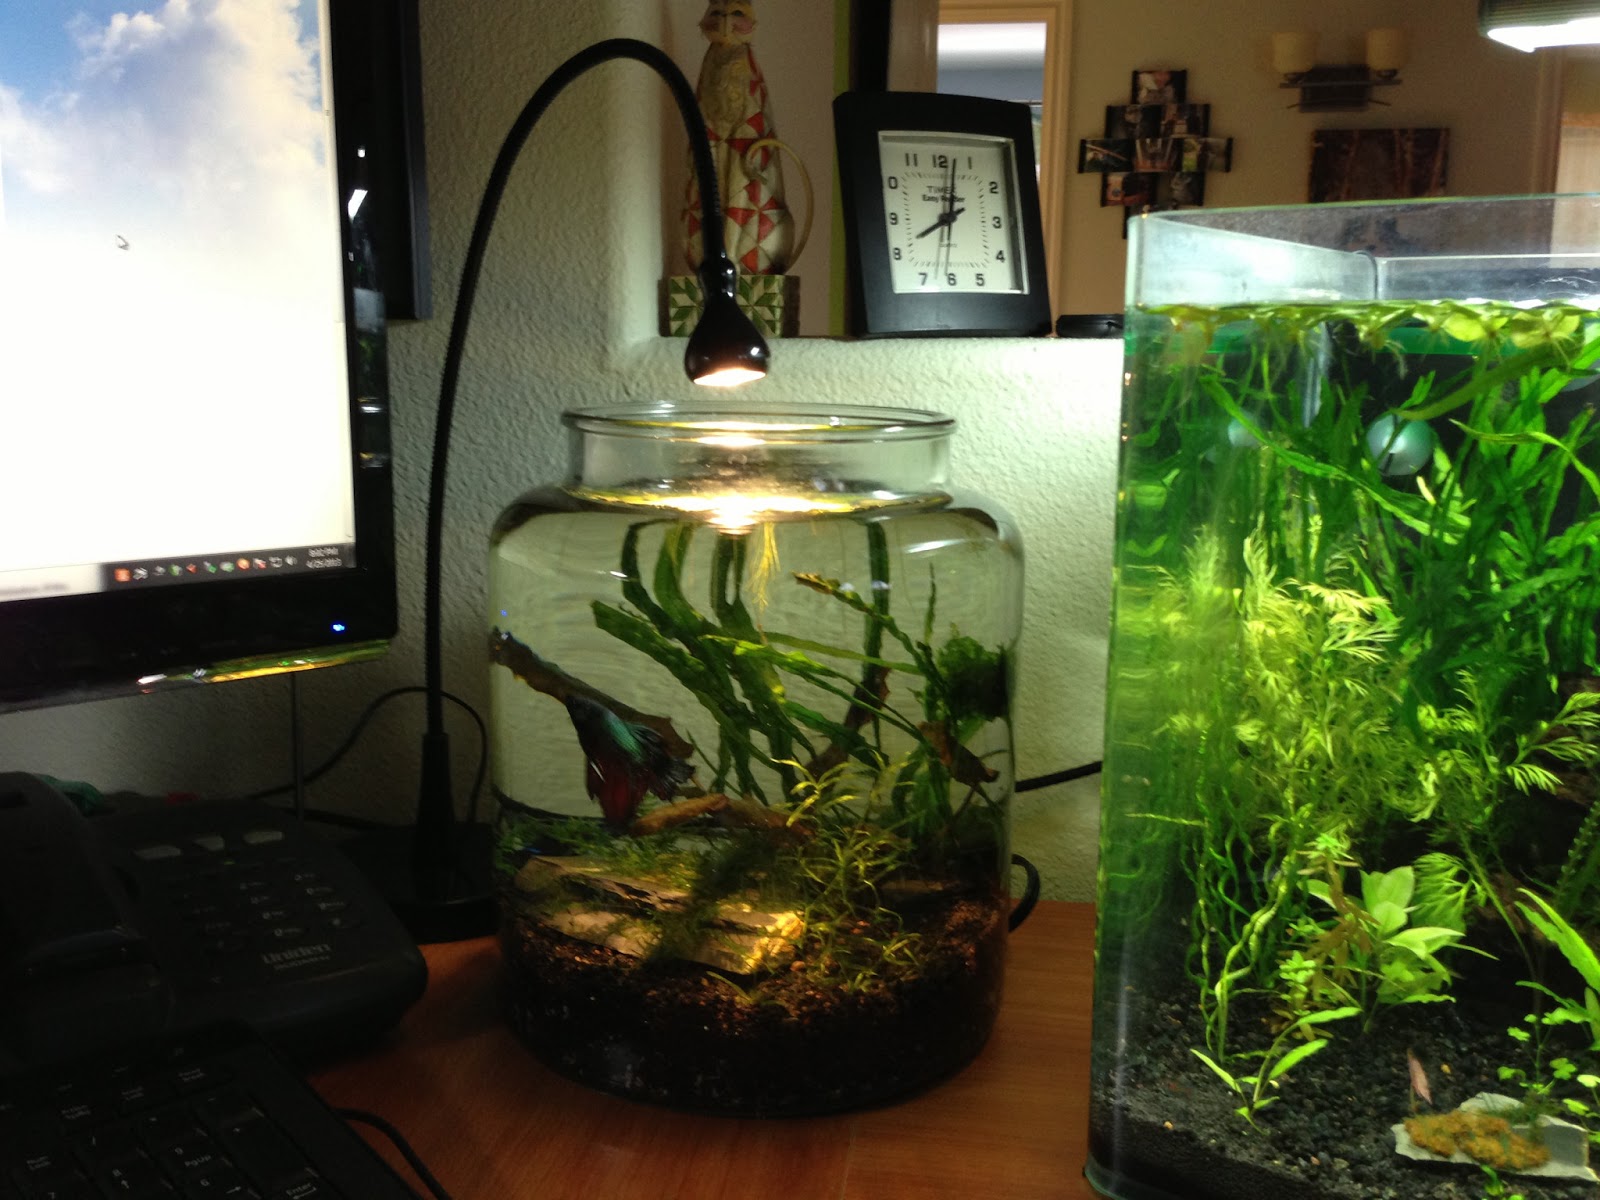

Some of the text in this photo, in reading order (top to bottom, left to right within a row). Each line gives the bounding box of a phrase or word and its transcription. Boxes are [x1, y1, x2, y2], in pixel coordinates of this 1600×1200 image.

[905, 153, 918, 167] 11
[932, 154, 949, 169] 12
[967, 156, 973, 170] 1
[888, 176, 898, 190] 0
[988, 181, 999, 195] 2
[941, 194, 966, 203] Reder
[889, 212, 899, 226] 9
[992, 216, 1002, 229] 3
[893, 247, 902, 261] 8
[995, 250, 1006, 263] 4
[918, 272, 928, 286] 7
[947, 273, 957, 287] 6
[976, 273, 986, 287] 5
